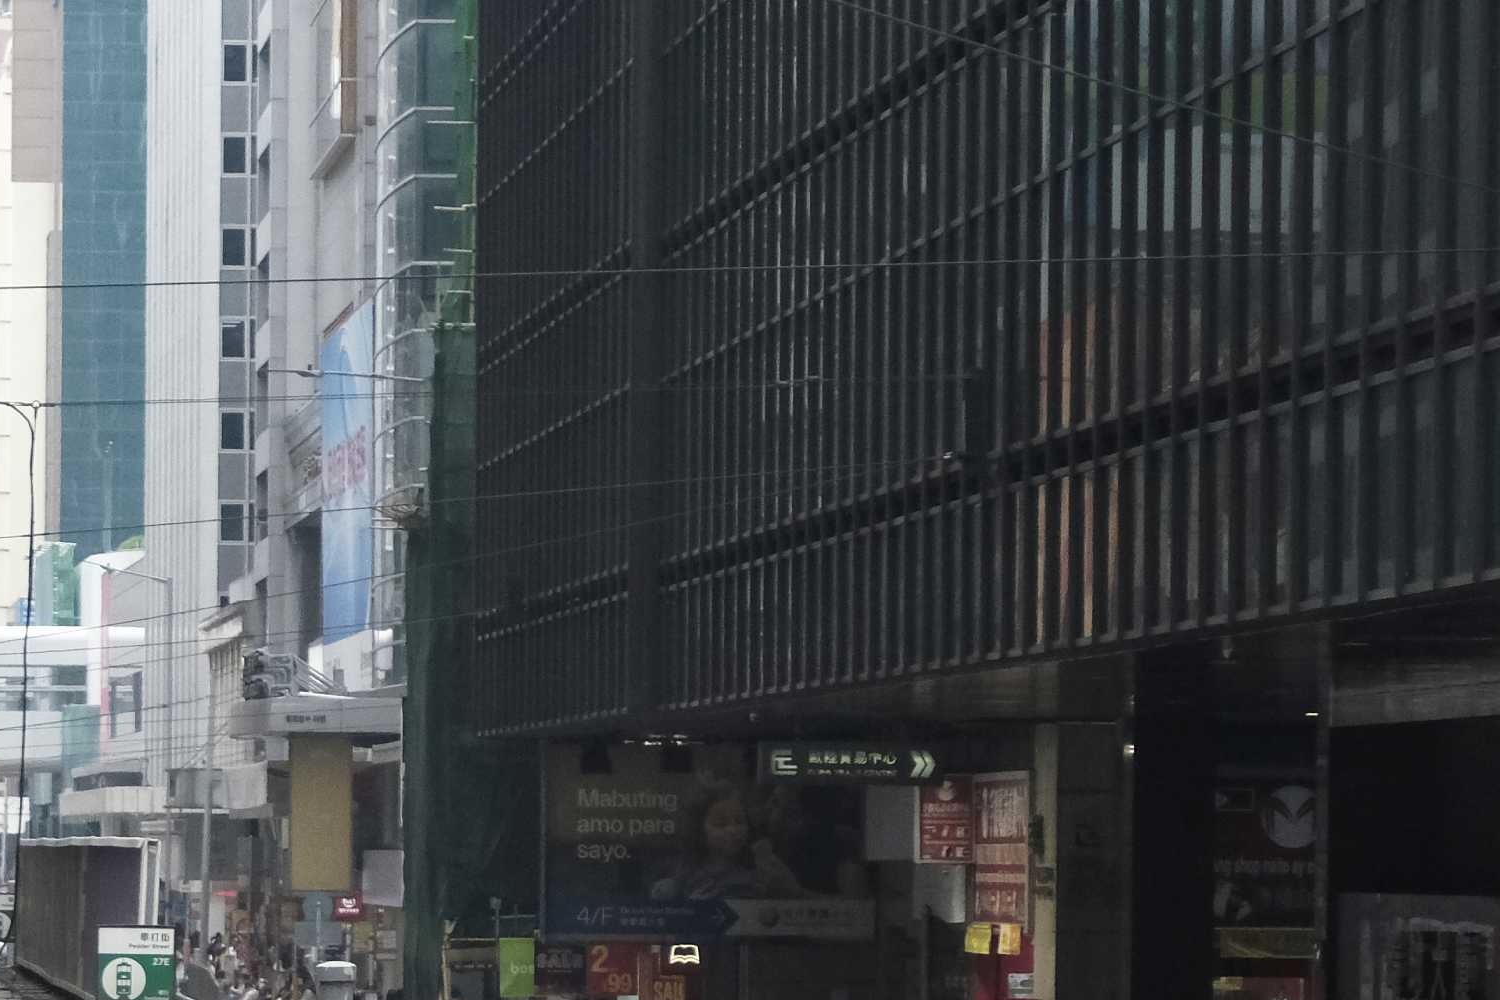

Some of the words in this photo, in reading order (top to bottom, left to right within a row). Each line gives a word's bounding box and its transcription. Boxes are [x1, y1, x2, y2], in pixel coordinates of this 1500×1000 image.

[578, 787, 677, 812] Mabuting
[577, 818, 625, 833] amo
[628, 818, 676, 837] para
[578, 843, 632, 863] sayo.
[576, 906, 613, 927] 4/F
[152, 957, 171, 966] 27E
